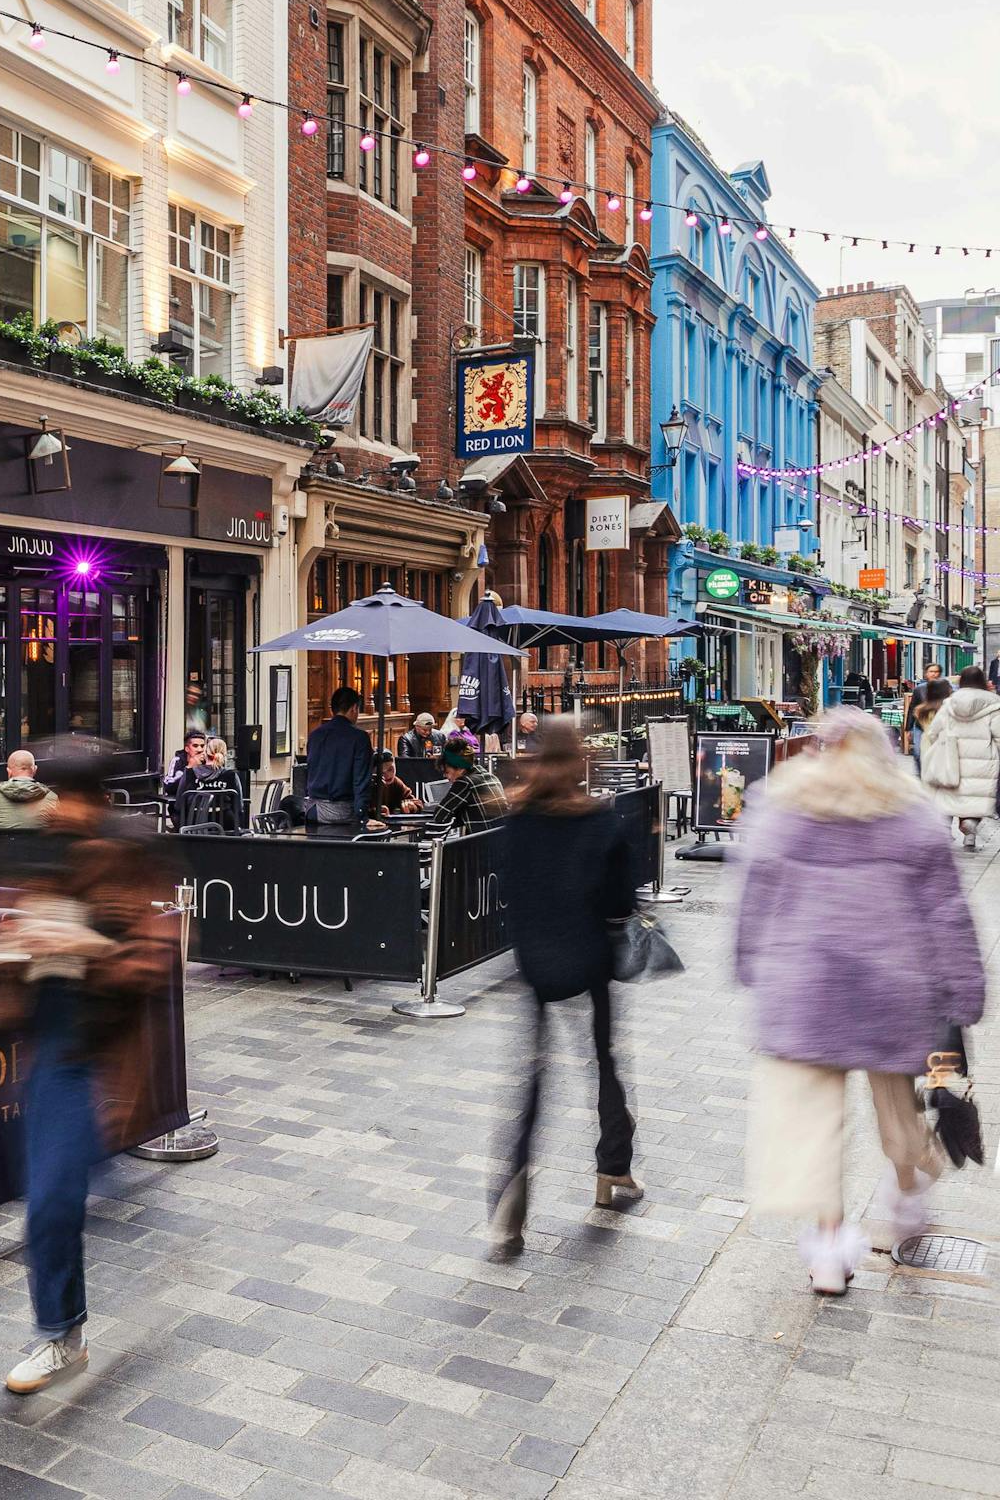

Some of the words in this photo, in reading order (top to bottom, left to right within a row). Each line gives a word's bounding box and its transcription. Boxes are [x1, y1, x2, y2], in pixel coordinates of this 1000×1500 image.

[465, 438, 490, 452] RED
[494, 435, 524, 449] LION
[592, 514, 619, 523] DIRTY
[590, 523, 621, 531] BONES
[461, 675, 480, 689] KLIN
[184, 877, 348, 930] INJUU
[468, 873, 508, 920] JIN
